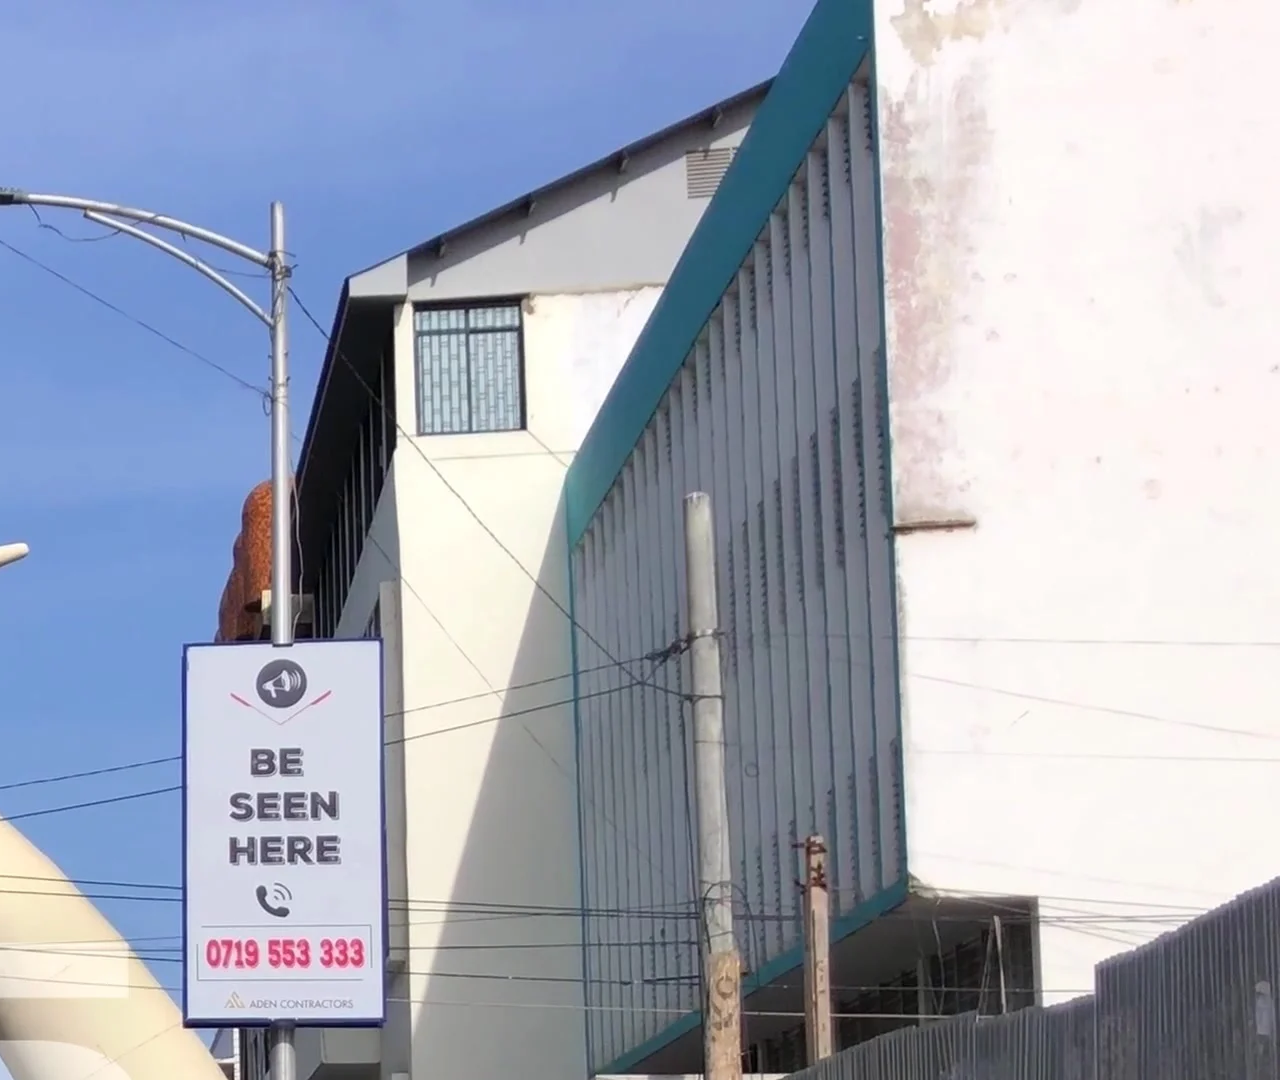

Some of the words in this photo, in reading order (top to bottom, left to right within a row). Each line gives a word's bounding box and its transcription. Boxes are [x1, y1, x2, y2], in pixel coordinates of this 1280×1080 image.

[250, 748, 304, 777] BE
[229, 791, 340, 822] SEEN
[229, 835, 341, 866] HERE
[206, 939, 260, 969] 0719
[268, 938, 311, 968] 553
[320, 938, 364, 968] 333
[249, 999, 277, 1009] ADEN
[280, 999, 354, 1009] CONTRACTORS
